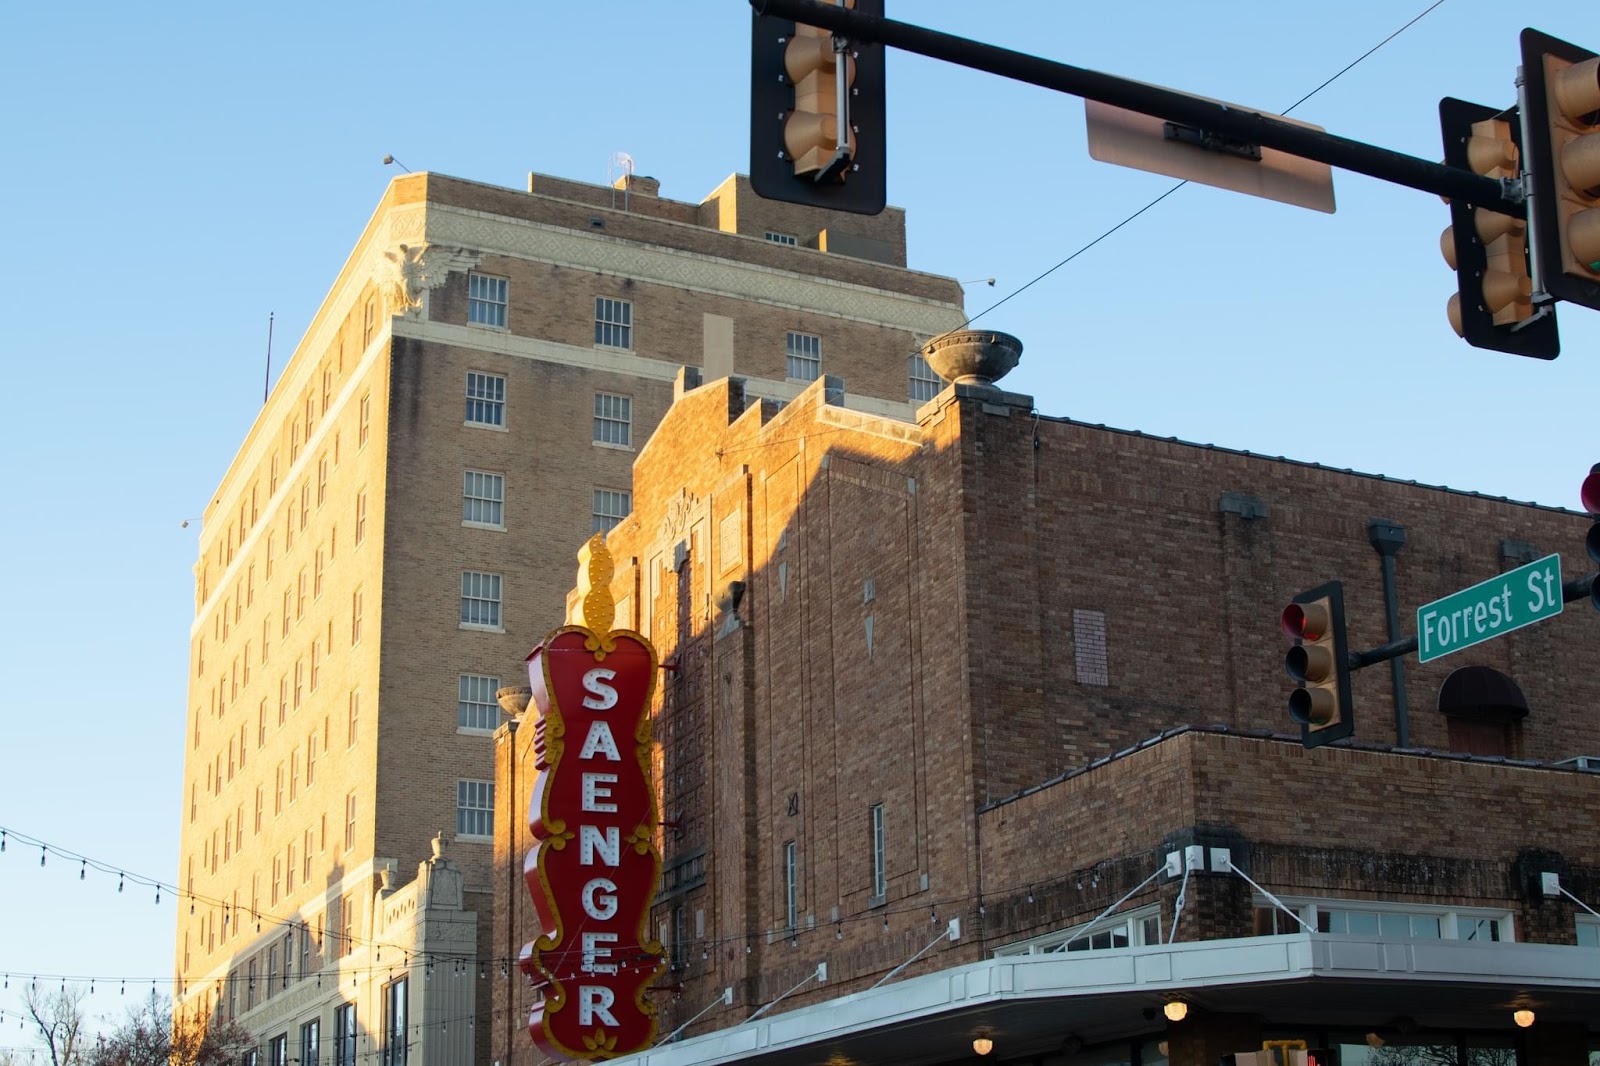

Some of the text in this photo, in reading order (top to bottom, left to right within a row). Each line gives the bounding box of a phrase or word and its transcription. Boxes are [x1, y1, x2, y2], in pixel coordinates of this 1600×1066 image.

[1423, 566, 1556, 653] Forrest St
[578, 668, 621, 1027] SAENGER
